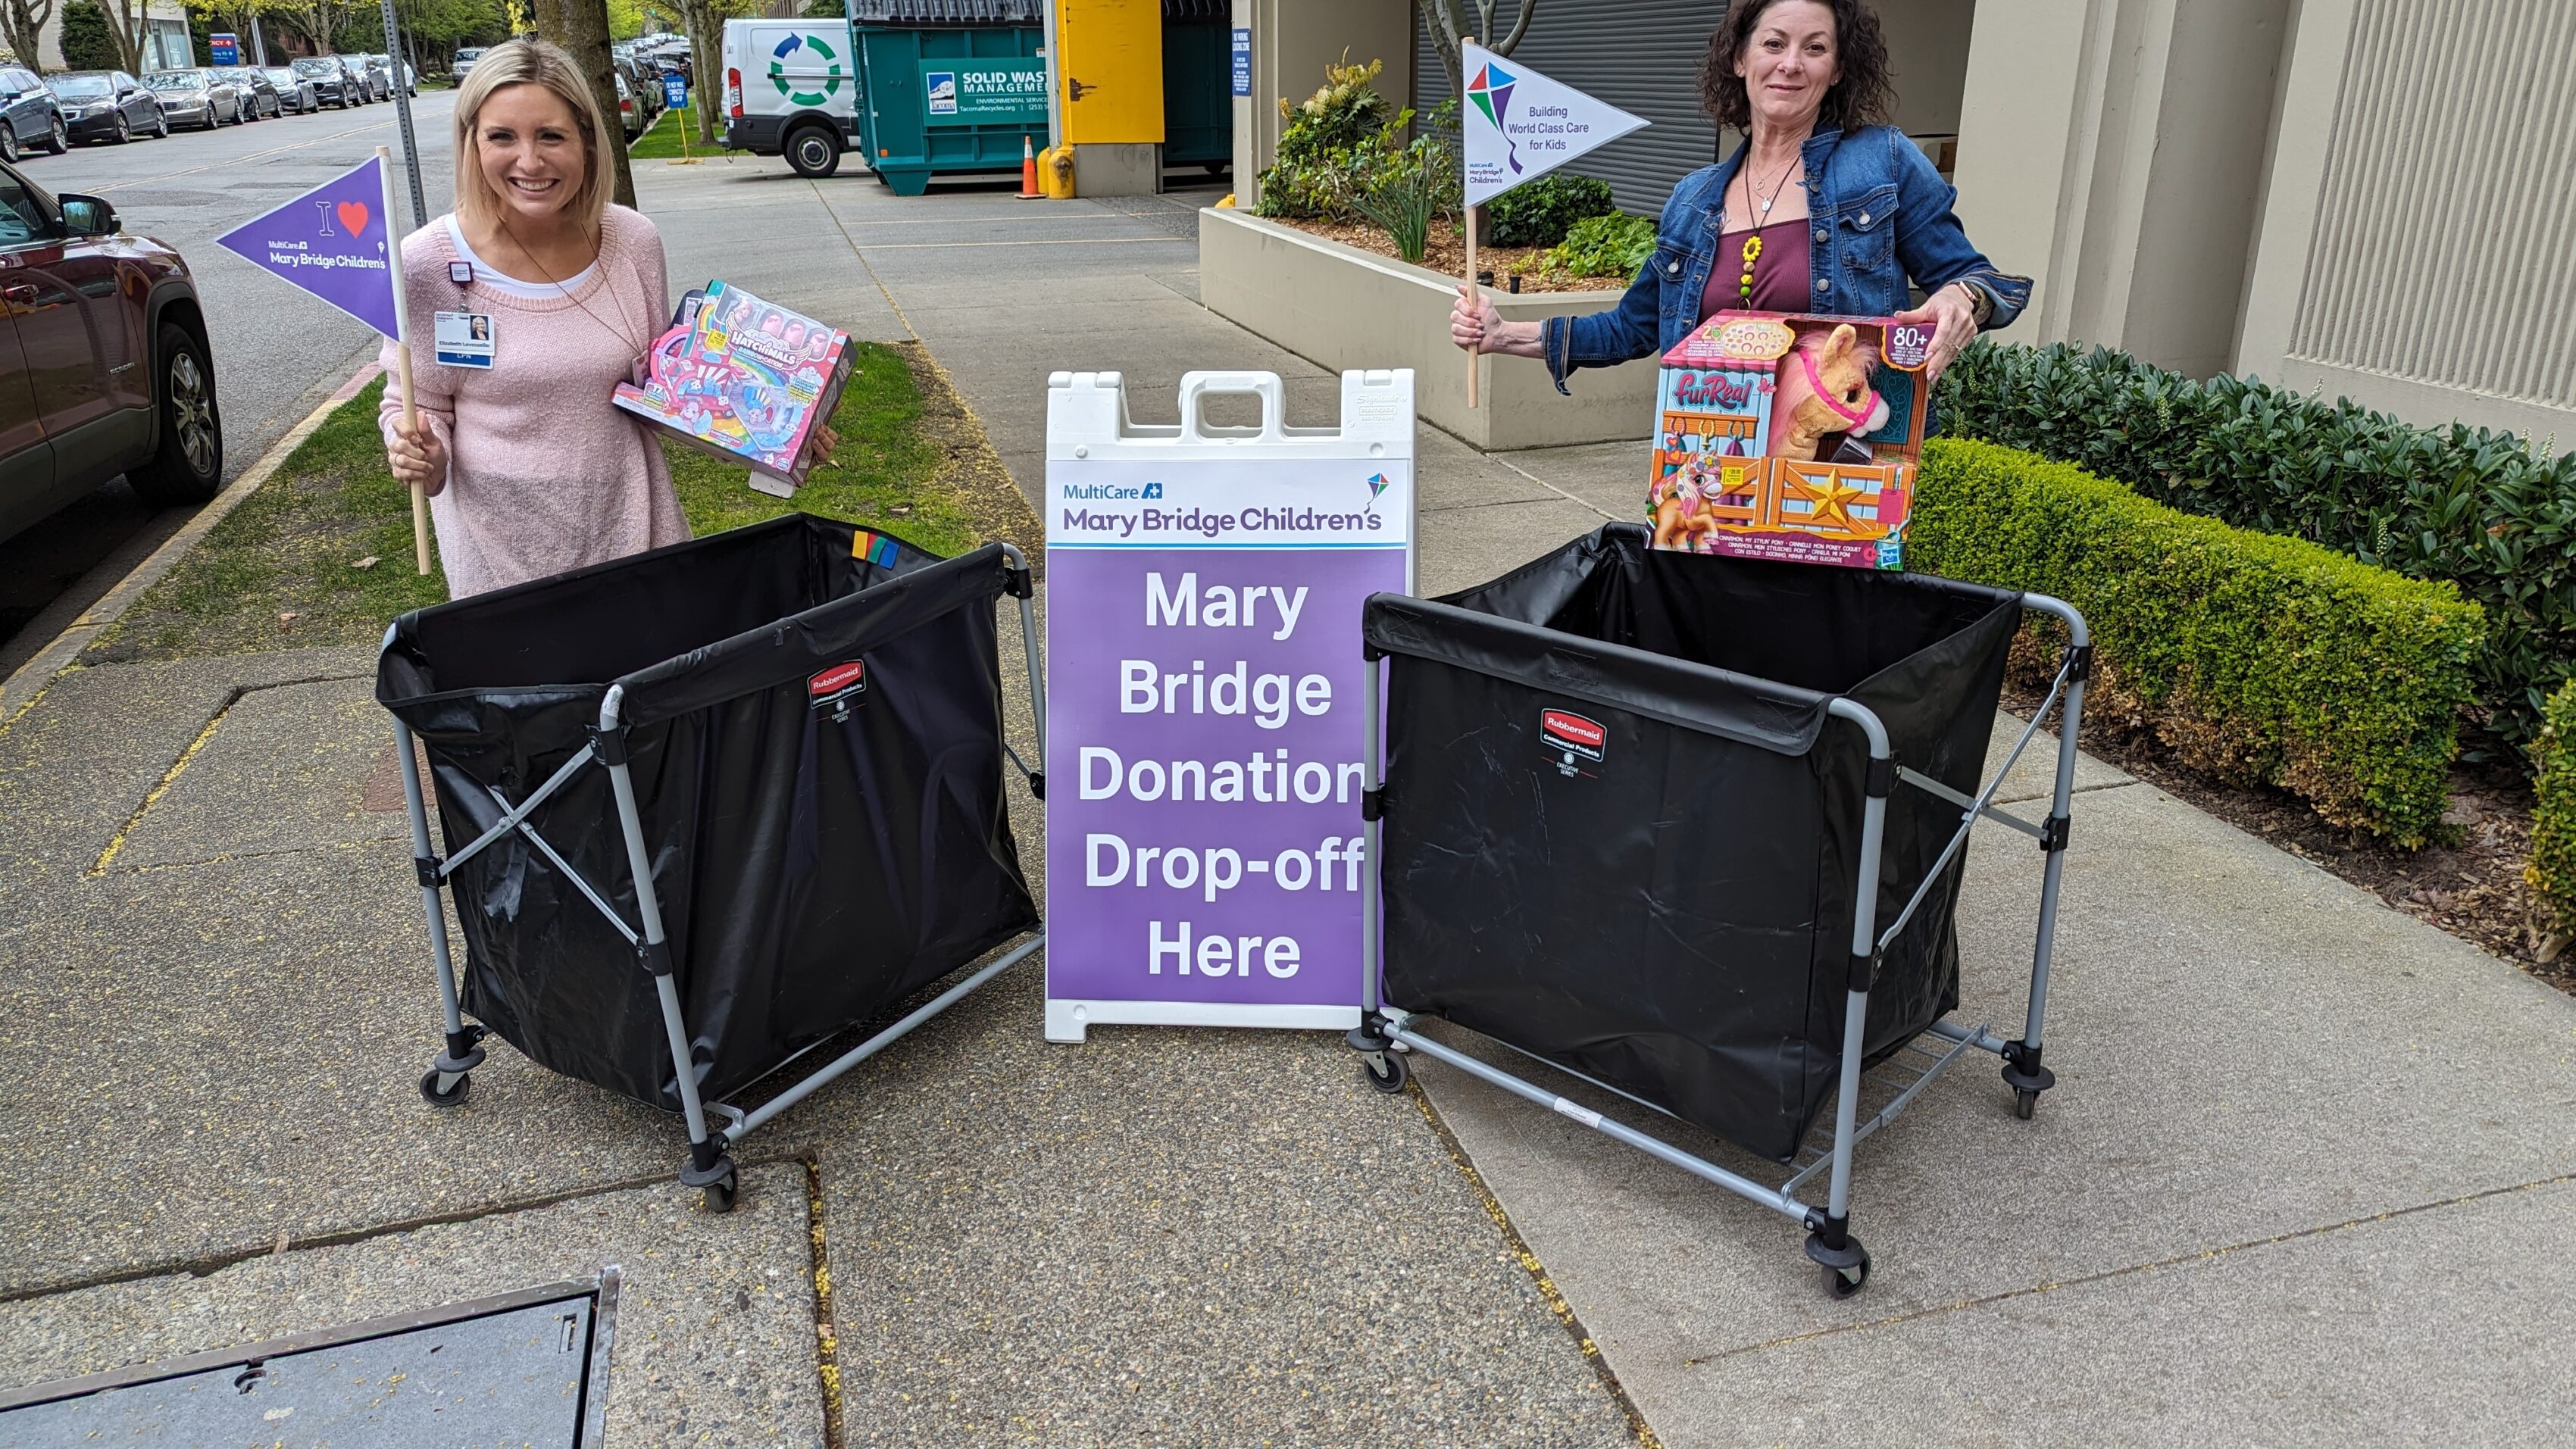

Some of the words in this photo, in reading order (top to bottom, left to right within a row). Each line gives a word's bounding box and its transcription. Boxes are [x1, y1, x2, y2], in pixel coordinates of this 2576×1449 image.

[962, 72, 1007, 84] SOLID
[931, 100, 955, 109] Tacoma
[1529, 106, 1568, 119] Building
[1508, 123, 1536, 134] World
[1537, 123, 1564, 134] Class
[1566, 123, 1589, 133] Care
[1529, 139, 1543, 150] for
[1545, 139, 1566, 150] Kids
[315, 201, 335, 236] I
[268, 241, 299, 250] MultiCare
[270, 251, 299, 267] Mary
[299, 253, 336, 270] Bridge
[336, 255, 386, 270] Children's
[1701, 324, 1721, 339] 26
[1893, 326, 1927, 347] 80+
[1063, 482, 1139, 501] MultiCare
[1063, 507, 1138, 538] Mary
[1142, 507, 1236, 538] Bridge
[1240, 507, 1382, 531] Children's
[1146, 572, 1309, 642] Mary
[813, 667, 858, 690] Rubbermaid
[812, 691, 842, 705] Commercial
[842, 683, 863, 695] Products
[1120, 660, 1332, 729] Bridge
[1547, 717, 1600, 741] Rubbermaid
[1543, 733, 1574, 749] Commercial
[1575, 744, 1600, 758] Products
[1079, 746, 1365, 804] Donation
[1556, 761, 1579, 773] EXECUTIVE
[1561, 768, 1574, 778] SERIES
[1086, 833, 1365, 903] Drop-off
[1149, 920, 1301, 979] Here
